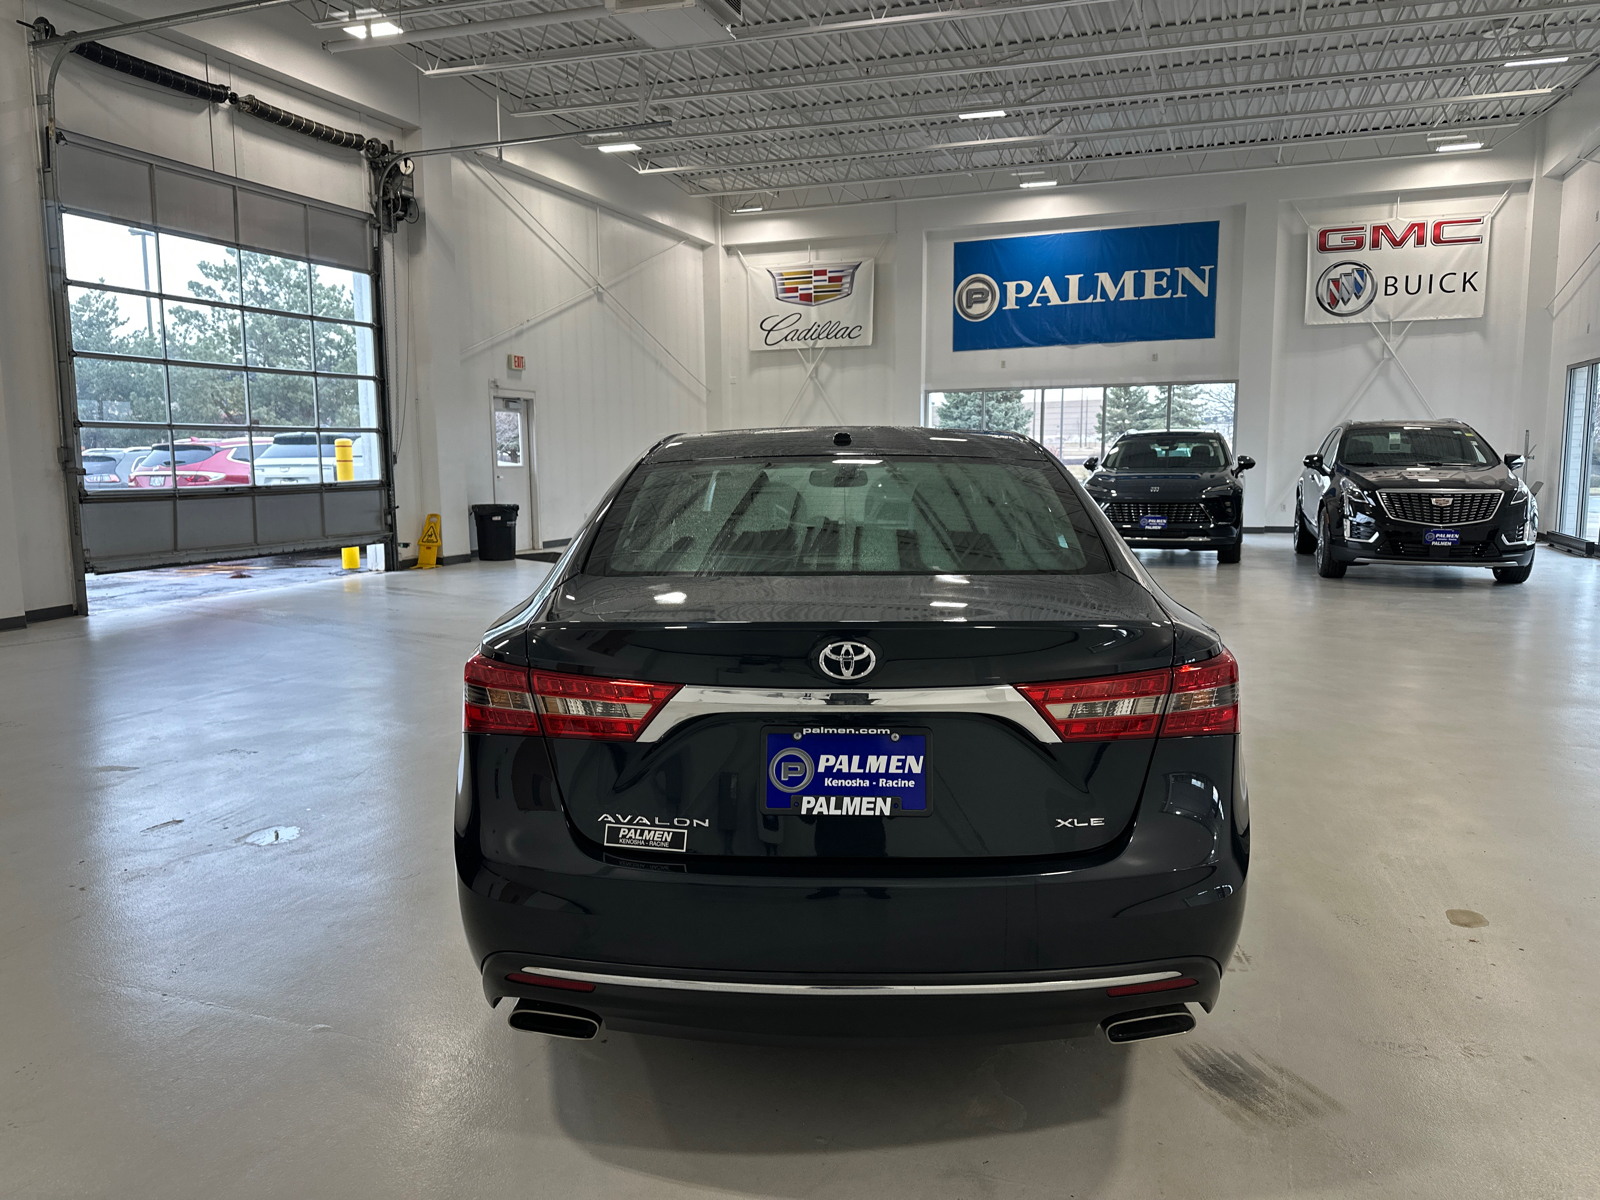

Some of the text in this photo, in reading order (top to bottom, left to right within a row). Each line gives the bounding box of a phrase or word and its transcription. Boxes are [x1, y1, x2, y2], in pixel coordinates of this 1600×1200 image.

[1317, 217, 1484, 254] GMC
[1002, 265, 1215, 310] PALMEN
[1383, 271, 1479, 297] BUICK
[759, 312, 863, 346] Cadillac
[514, 356, 524, 369] EXIT
[802, 727, 891, 735] palmen.com
[817, 754, 924, 774] PALMEN
[824, 777, 869, 787] Kenosha
[878, 778, 915, 788] Racine
[801, 796, 892, 816] PALMEN
[597, 813, 710, 828] AVALON
[1055, 817, 1105, 828] XLE
[619, 828, 673, 842] PALMEN
[619, 838, 645, 846] KENOSHA
